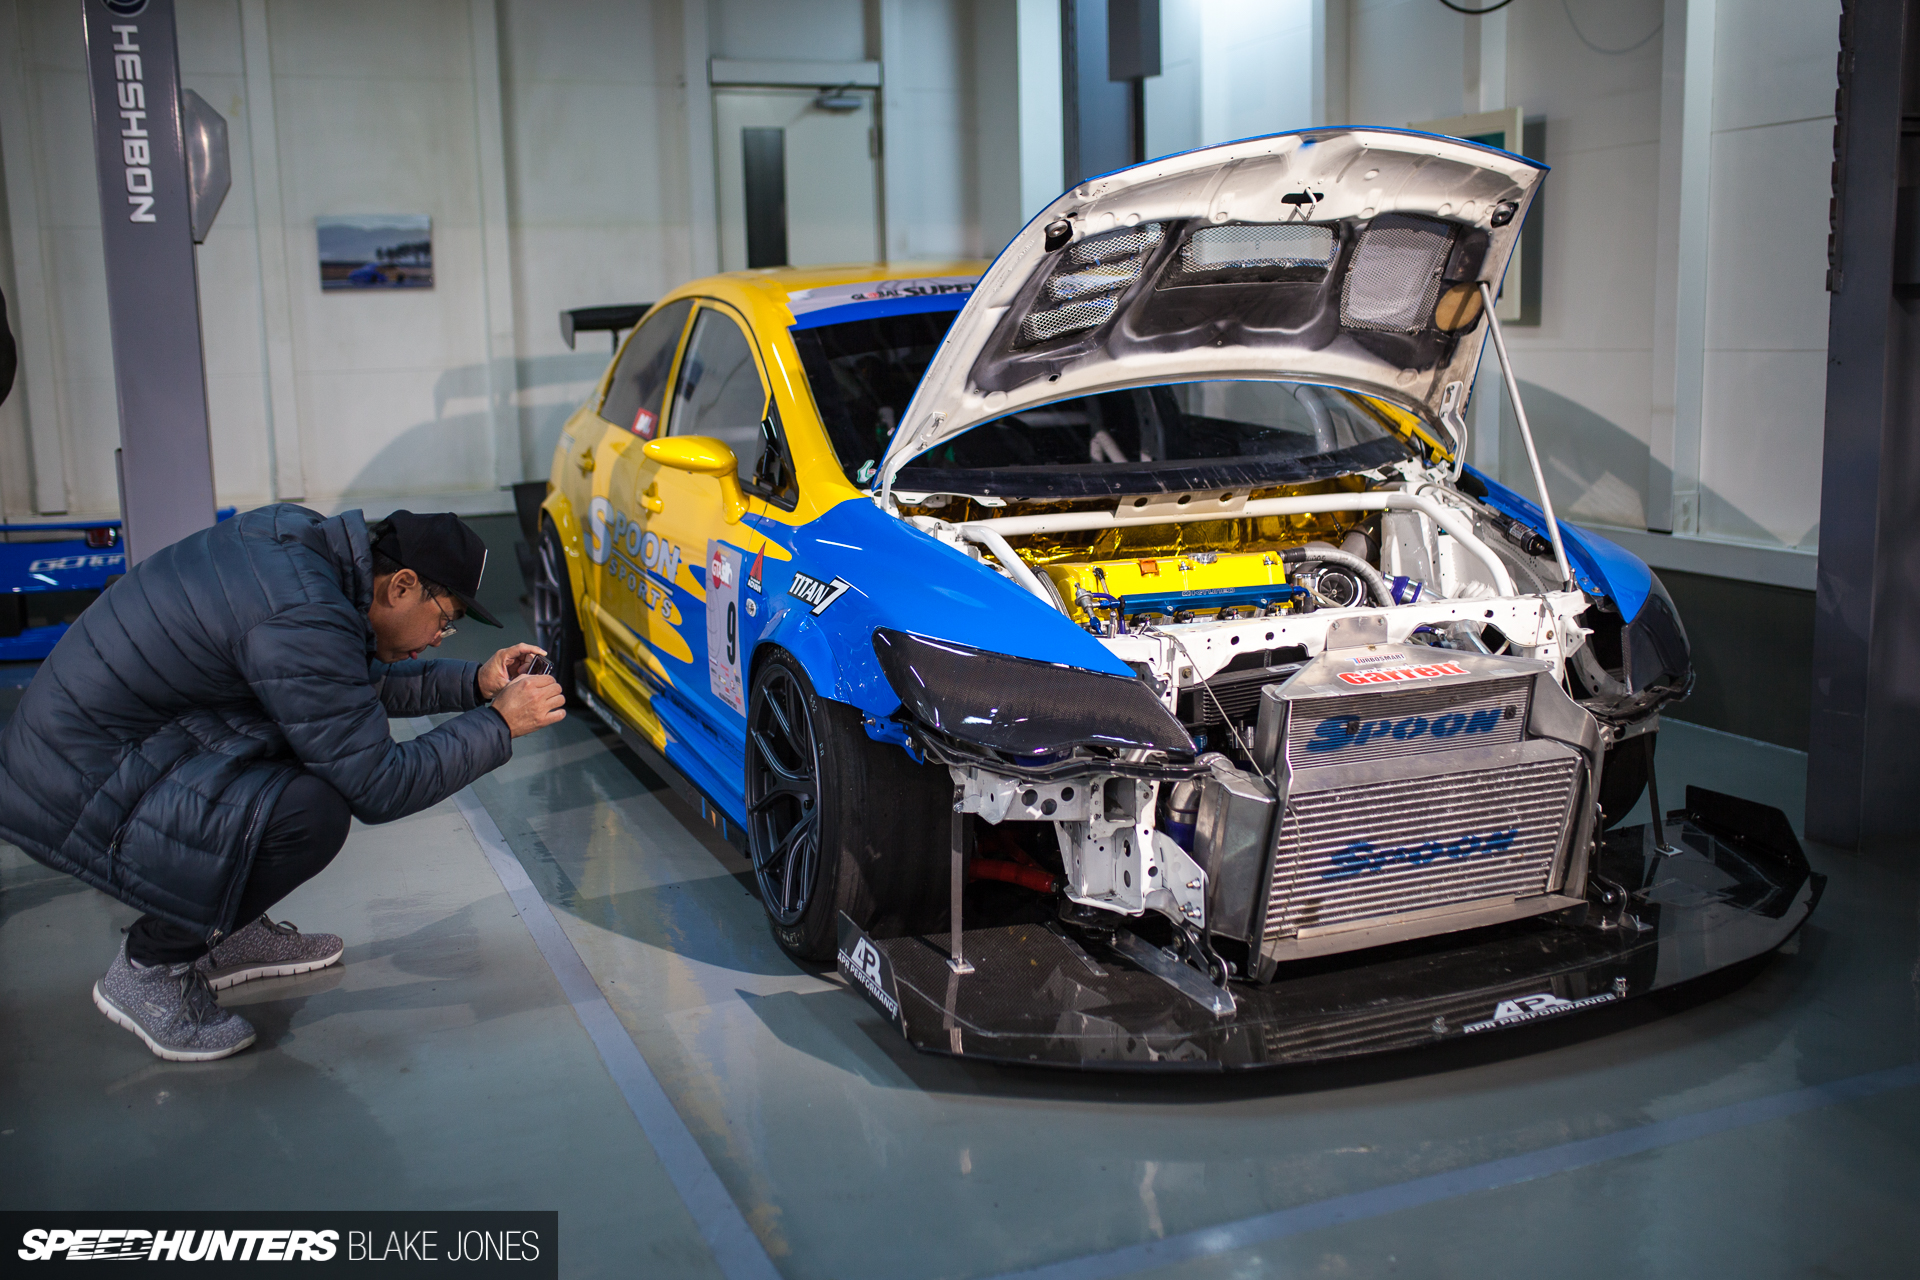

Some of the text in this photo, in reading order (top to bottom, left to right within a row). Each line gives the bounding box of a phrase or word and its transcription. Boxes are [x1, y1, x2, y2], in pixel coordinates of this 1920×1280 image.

[111, 24, 157, 223] HESHBON
[583, 495, 681, 586] SPOON
[608, 556, 673, 619] SPORTS
[726, 601, 737, 666] 9
[1347, 653, 1406, 665] TURBOSMART
[1337, 662, 1469, 685] Garrett
[849, 963, 899, 1017] PERFORMANCE
[1463, 993, 1617, 1034] APR PERFORMANCE
